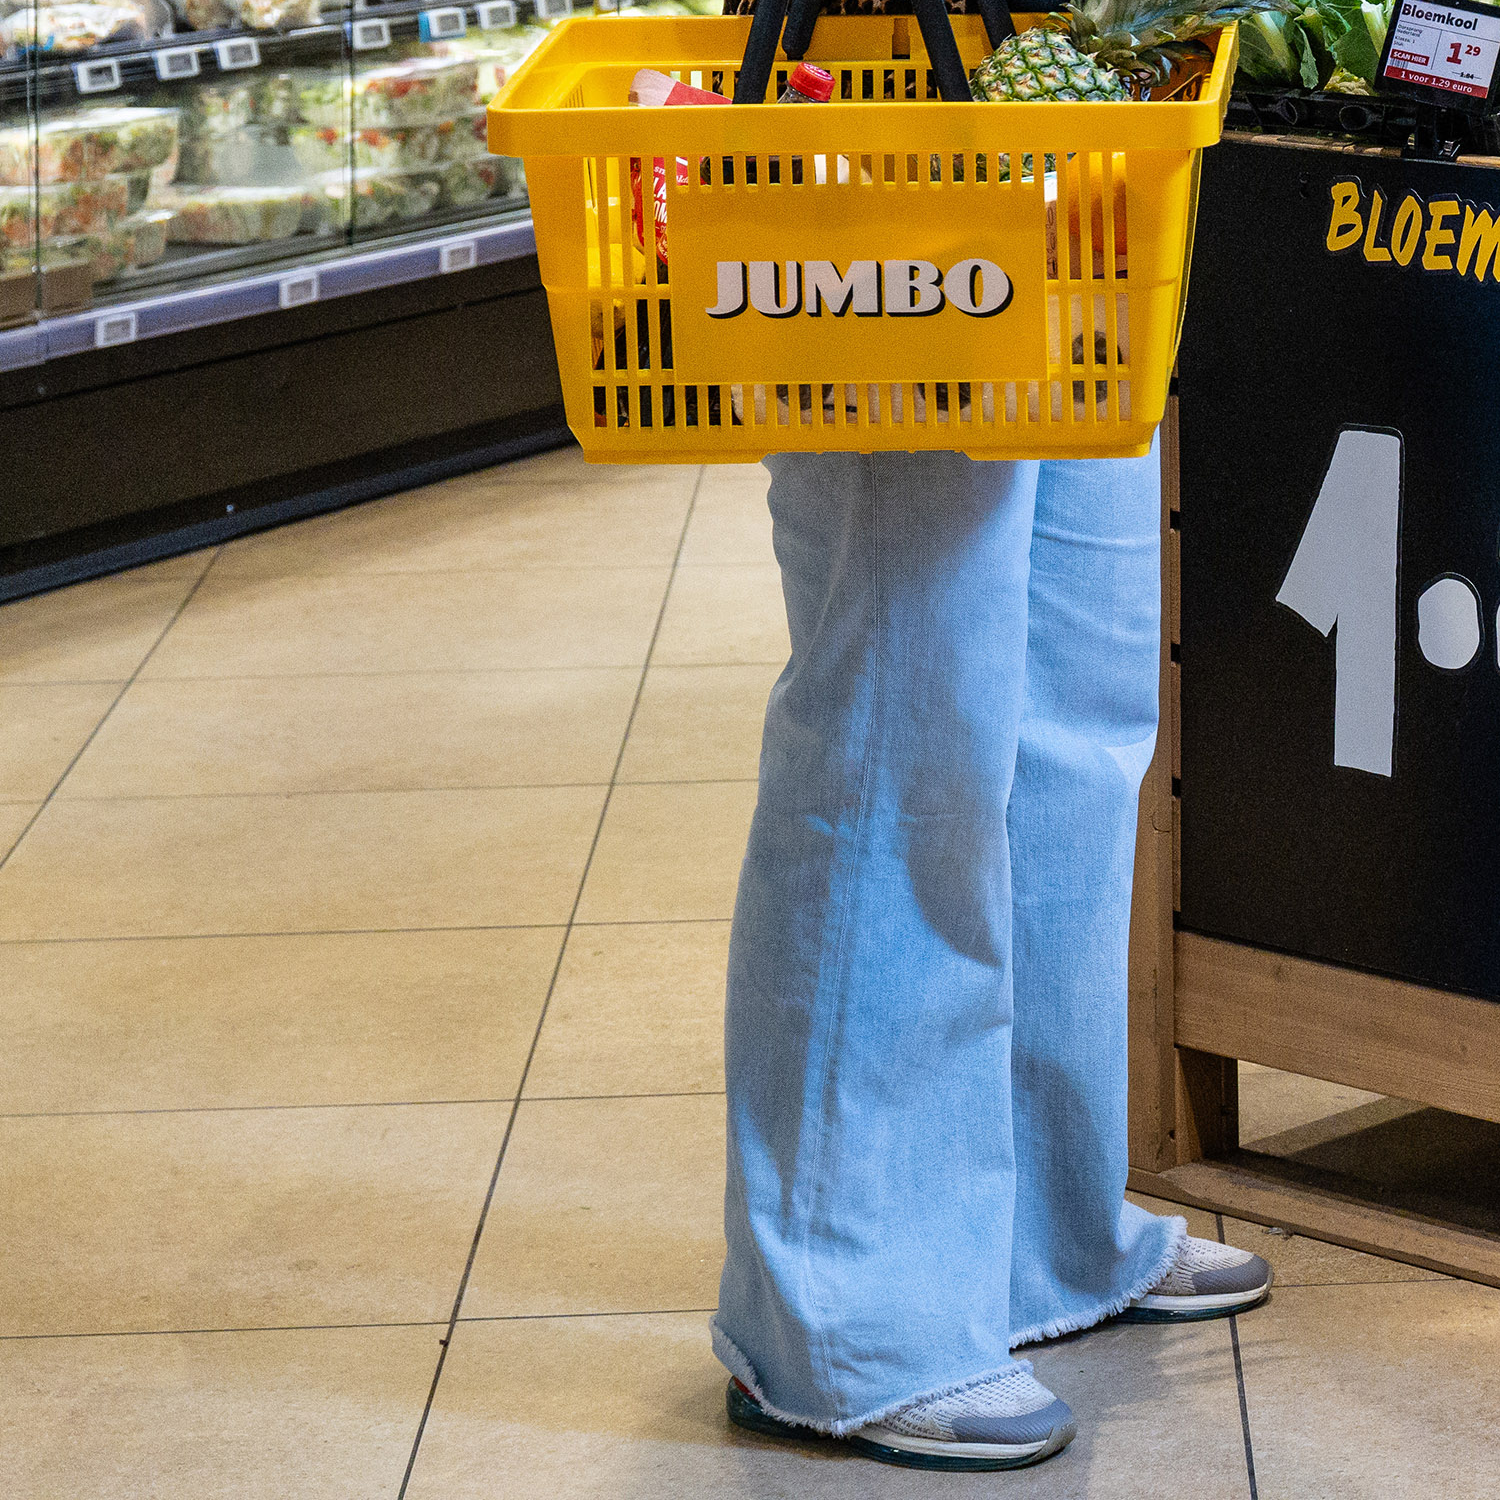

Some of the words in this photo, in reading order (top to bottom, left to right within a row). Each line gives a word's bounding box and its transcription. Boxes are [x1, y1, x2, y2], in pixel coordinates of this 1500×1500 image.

[1401, 3, 1478, 31] Bloemkool
[1393, 51, 1411, 61] SCAN
[1411, 54, 1427, 65] HIER
[1400, 70, 1406, 79] 1
[1408, 74, 1429, 84] voor
[1431, 77, 1451, 89] 1.29
[1452, 83, 1473, 93] euro
[706, 258, 1013, 319] JUMBO
